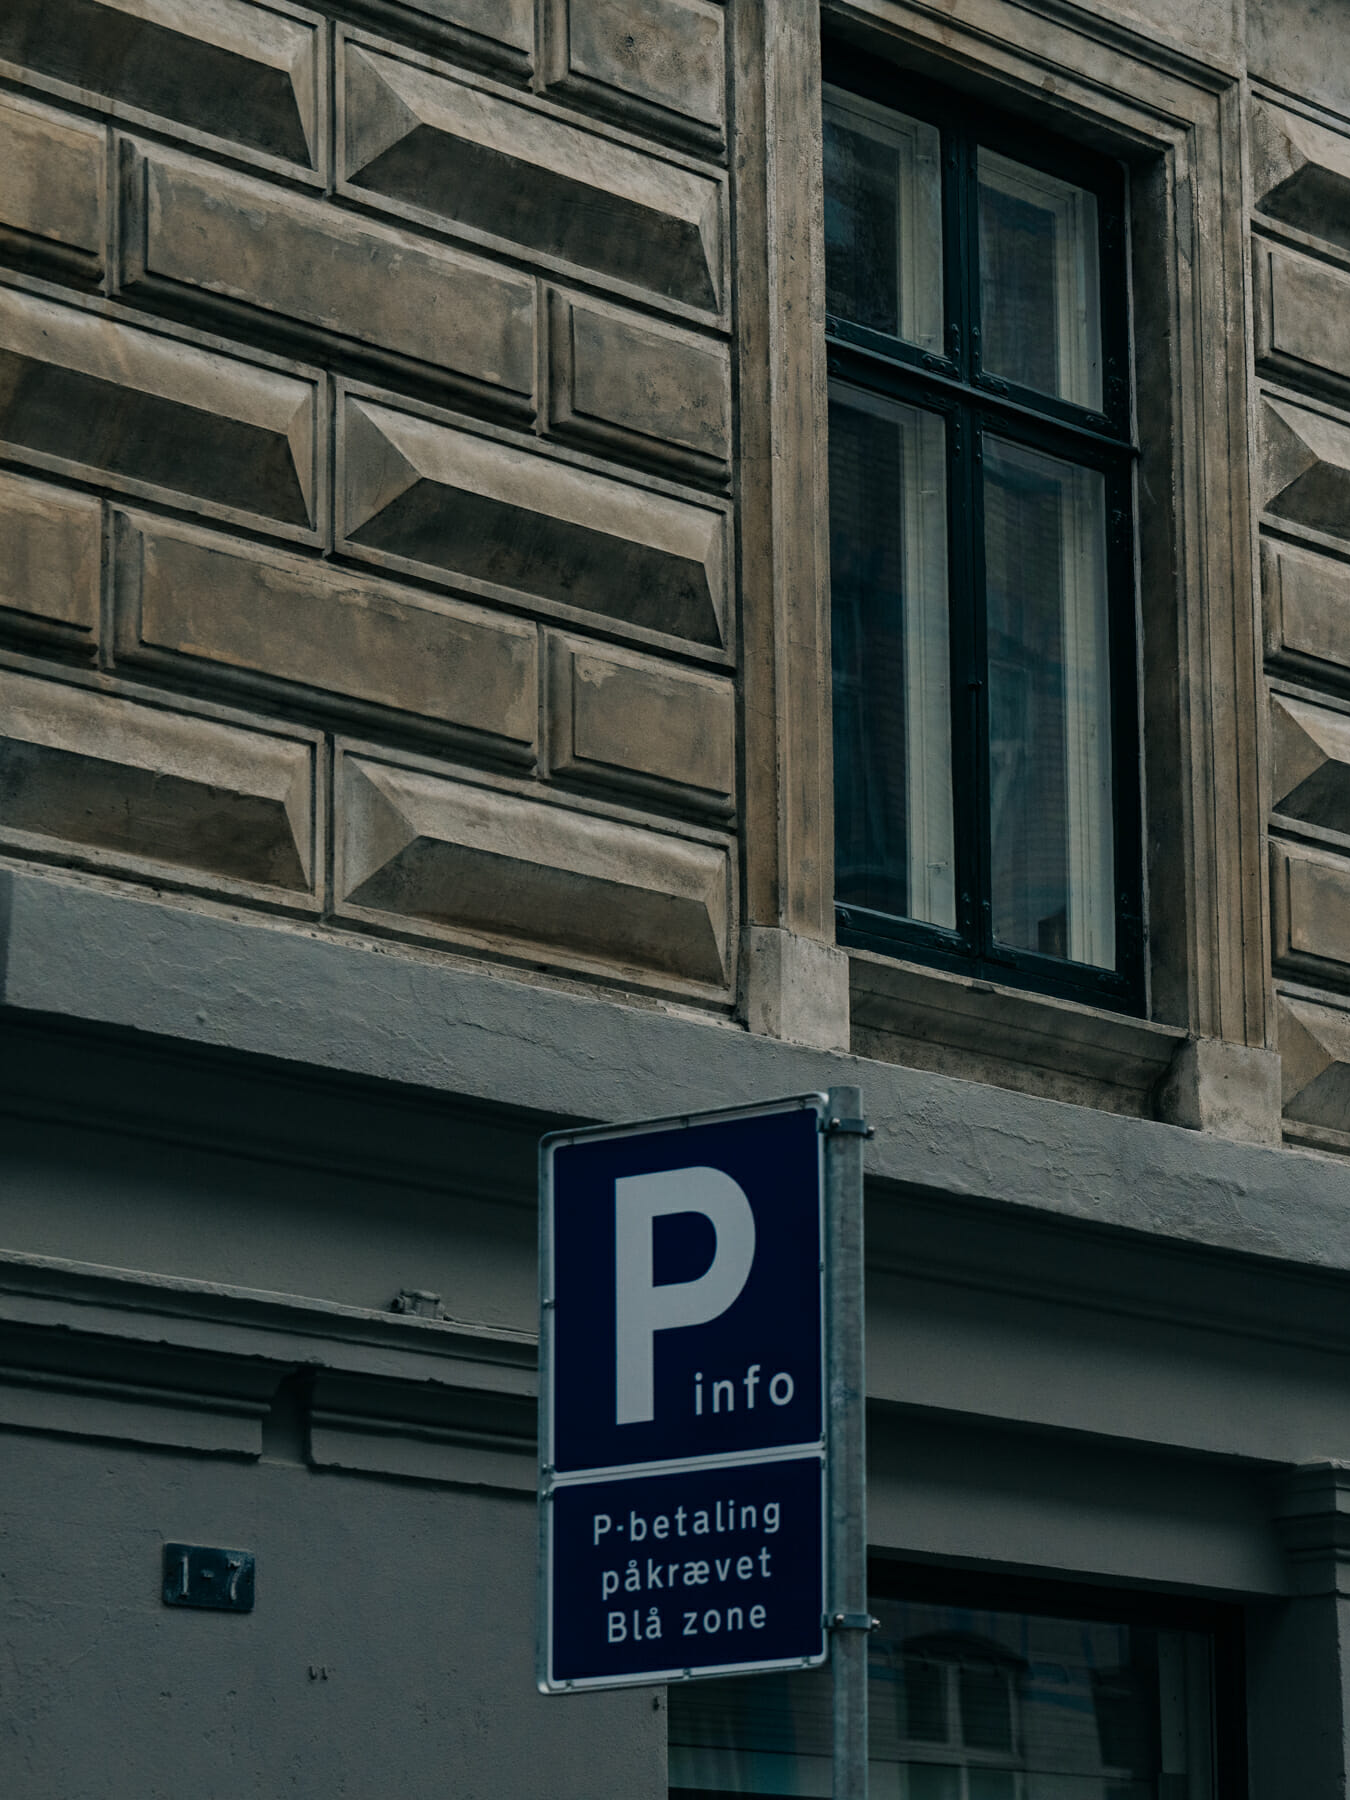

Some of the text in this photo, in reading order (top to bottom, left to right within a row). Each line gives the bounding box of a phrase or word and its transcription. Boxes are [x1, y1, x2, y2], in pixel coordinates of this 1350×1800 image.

[615, 1166, 757, 1425] P
[694, 1364, 795, 1416] info
[602, 1546, 772, 1601] påkrævet
[607, 1604, 767, 1643] Blå zone
